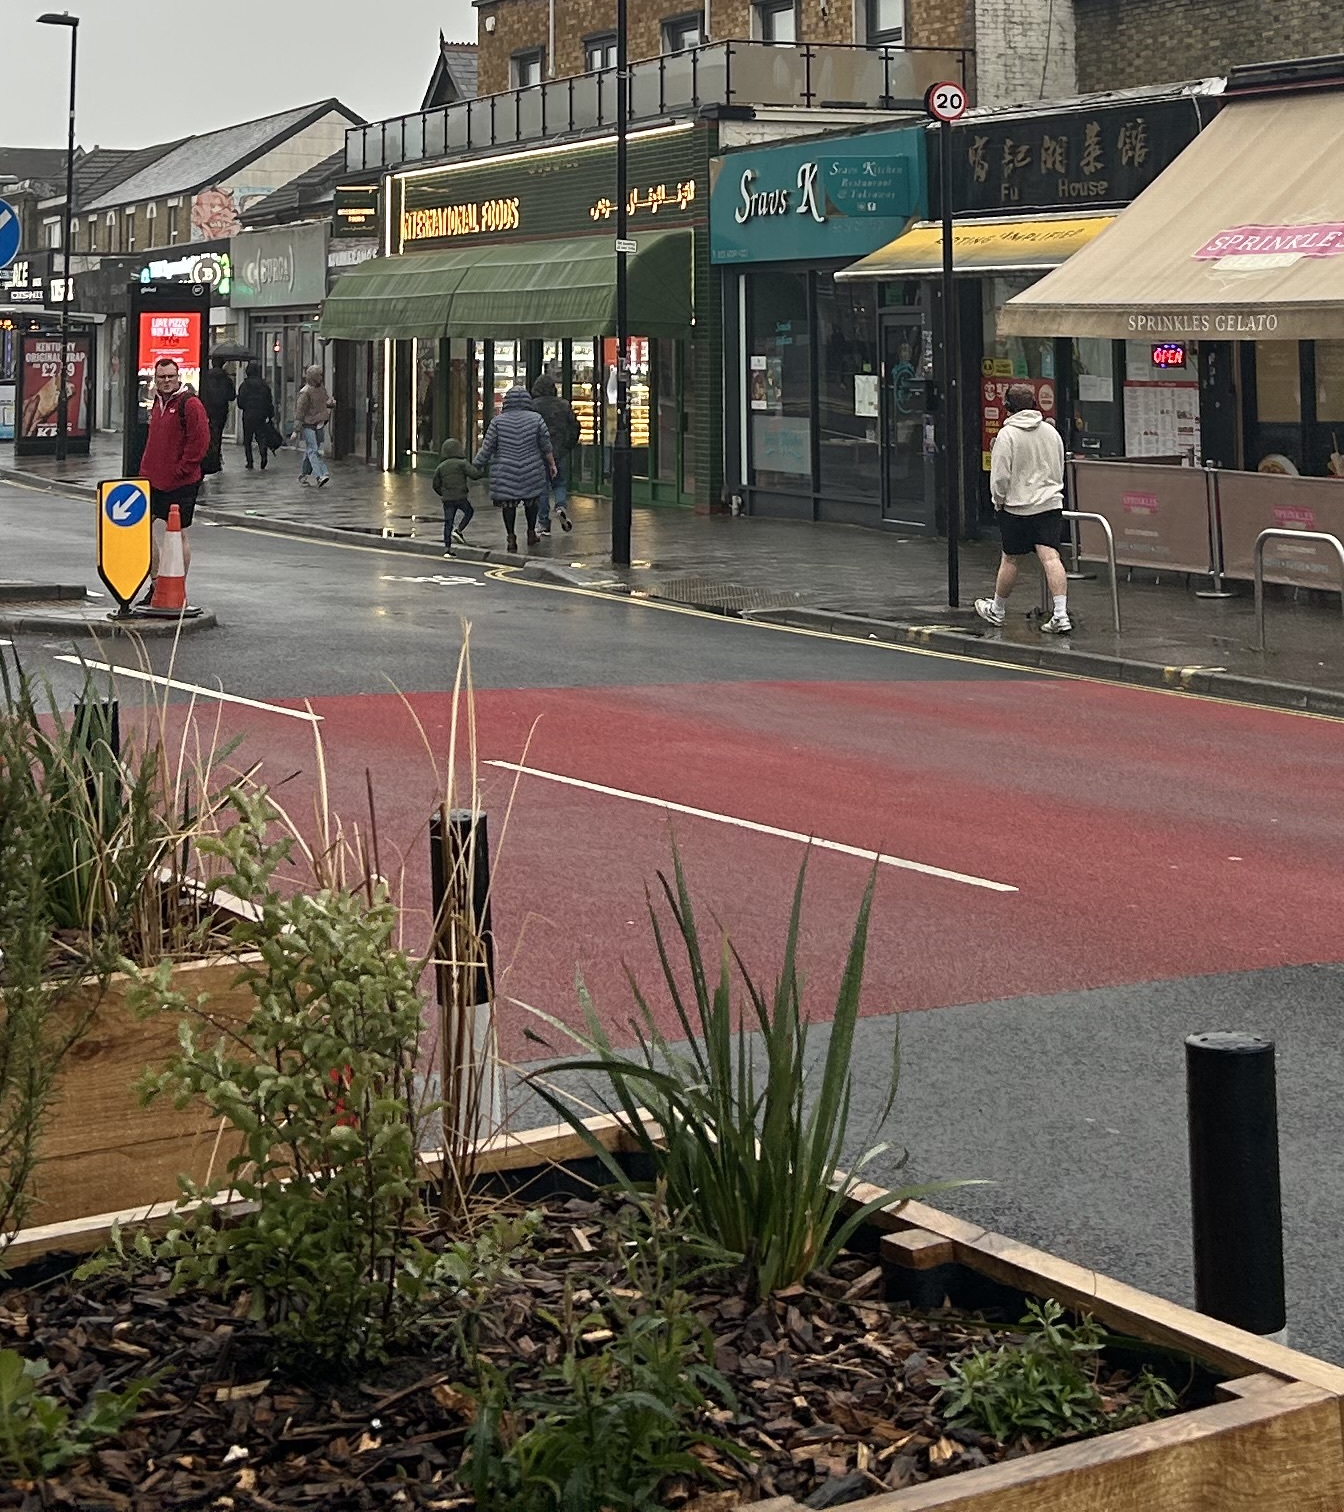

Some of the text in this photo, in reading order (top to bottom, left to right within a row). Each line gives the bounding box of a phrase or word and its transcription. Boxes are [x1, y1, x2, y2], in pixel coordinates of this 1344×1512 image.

[936, 93, 962, 110] 20
[735, 169, 788, 224] Sravs
[796, 163, 825, 223] K
[1001, 178, 1108, 201] Fu House
[481, 197, 520, 232] FOODS
[1128, 314, 1278, 332] SPRINKLES GELATO
[36, 342, 76, 352] KENTUKY
[25, 353, 62, 363] ORIGINAL
[1153, 349, 1184, 365] OPEN
[37, 428, 72, 437] KF
